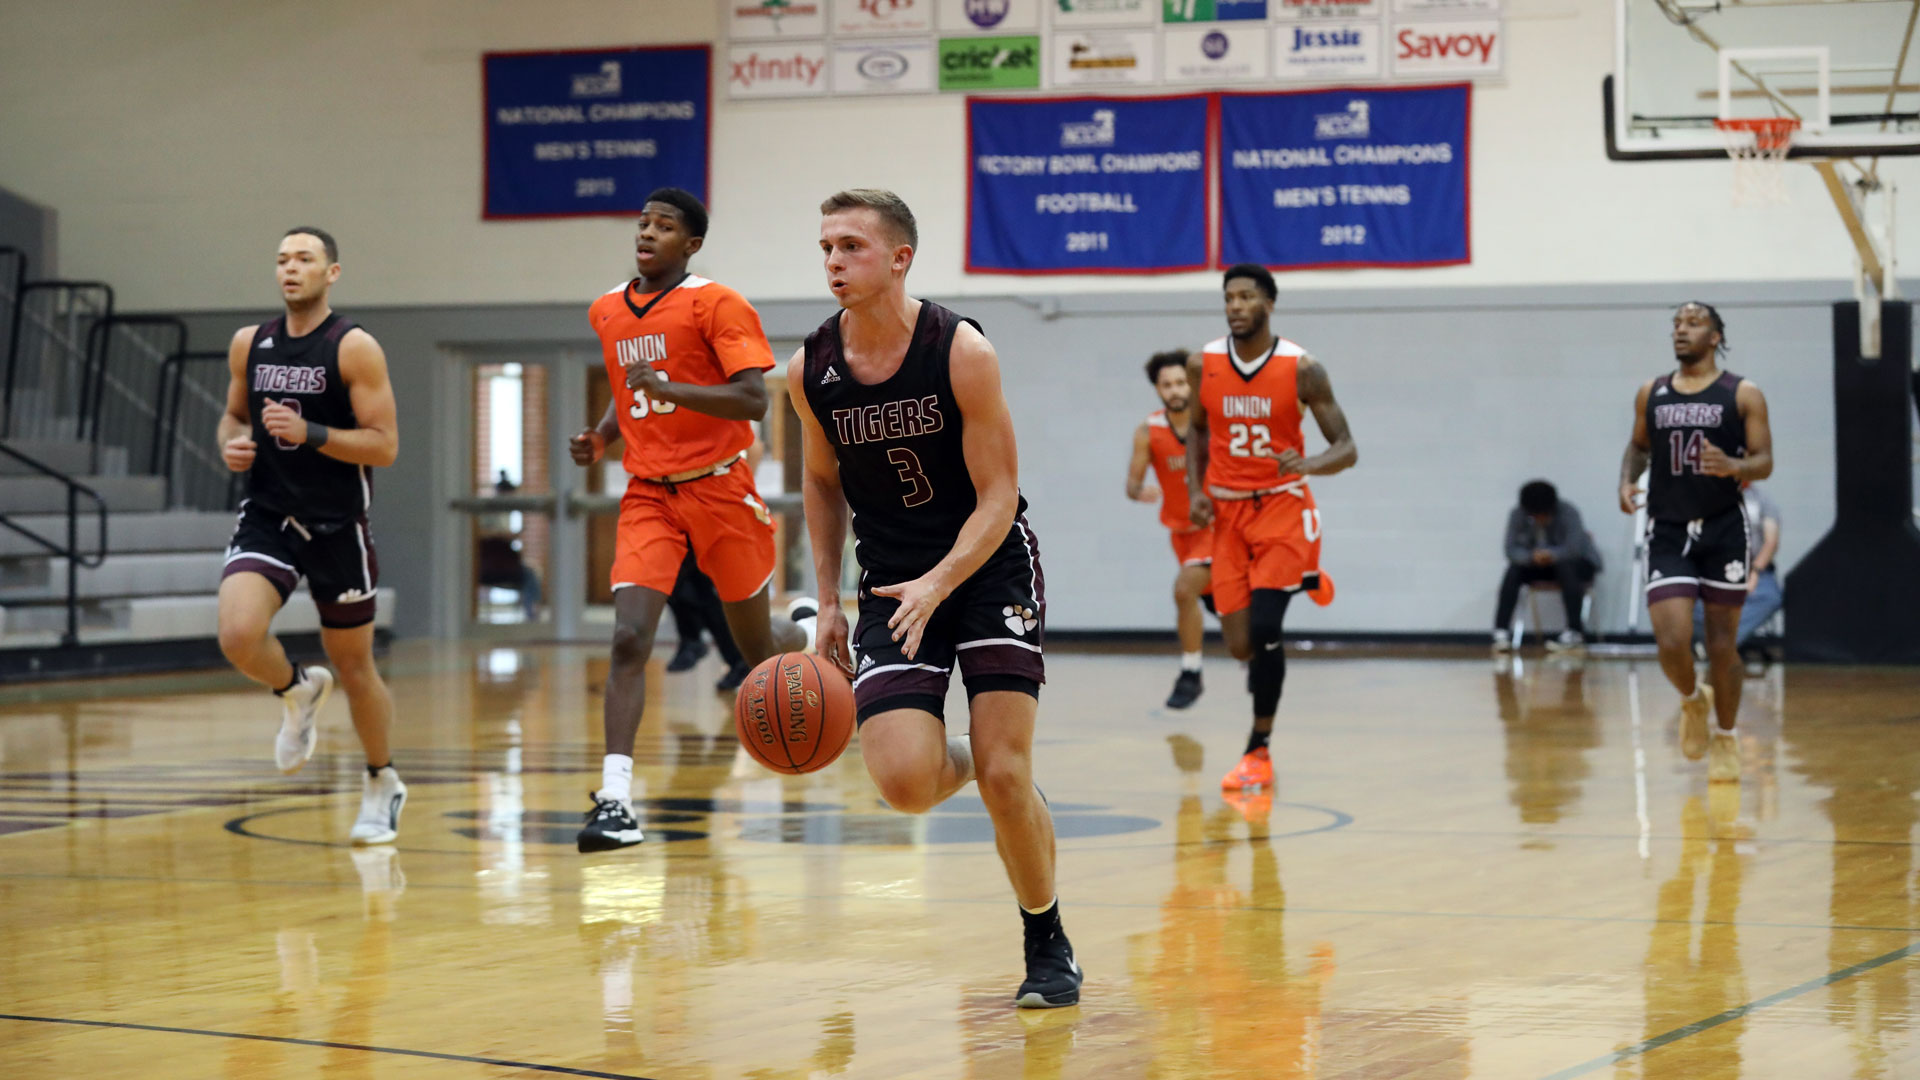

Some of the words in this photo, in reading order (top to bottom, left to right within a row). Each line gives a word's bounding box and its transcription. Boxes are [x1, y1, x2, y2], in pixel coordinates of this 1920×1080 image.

[1292, 27, 1361, 51] Jessie
[1398, 29, 1495, 64] Savoy
[730, 53, 825, 87] xfinity
[498, 106, 586, 125] NATIONAL
[589, 101, 695, 123] CHAMPIONS
[534, 141, 591, 160] MEN'S
[595, 139, 656, 159] TENNIS
[1233, 148, 1331, 169] NATIONAL
[1334, 142, 1453, 166] CHAMPIONS
[1049, 154, 1099, 175] BOWL
[1101, 151, 1201, 174] CHAMPIONS
[1036, 193, 1138, 214] FOOTBALL
[1273, 187, 1336, 208] MEN'S
[1339, 185, 1411, 206] TENNIS
[1066, 232, 1108, 252] 2011
[1321, 225, 1366, 246] 2012
[616, 333, 667, 367] UNION
[254, 364, 326, 394] TIGERS
[820, 375, 841, 385] adidas
[833, 394, 944, 445] TIGERS
[1222, 395, 1272, 419] UNION
[1655, 403, 1723, 429] TIGERS
[1229, 422, 1274, 458] 22
[1669, 429, 1704, 476] 14
[887, 447, 934, 508] 3
[782, 663, 807, 743] SPALDING
